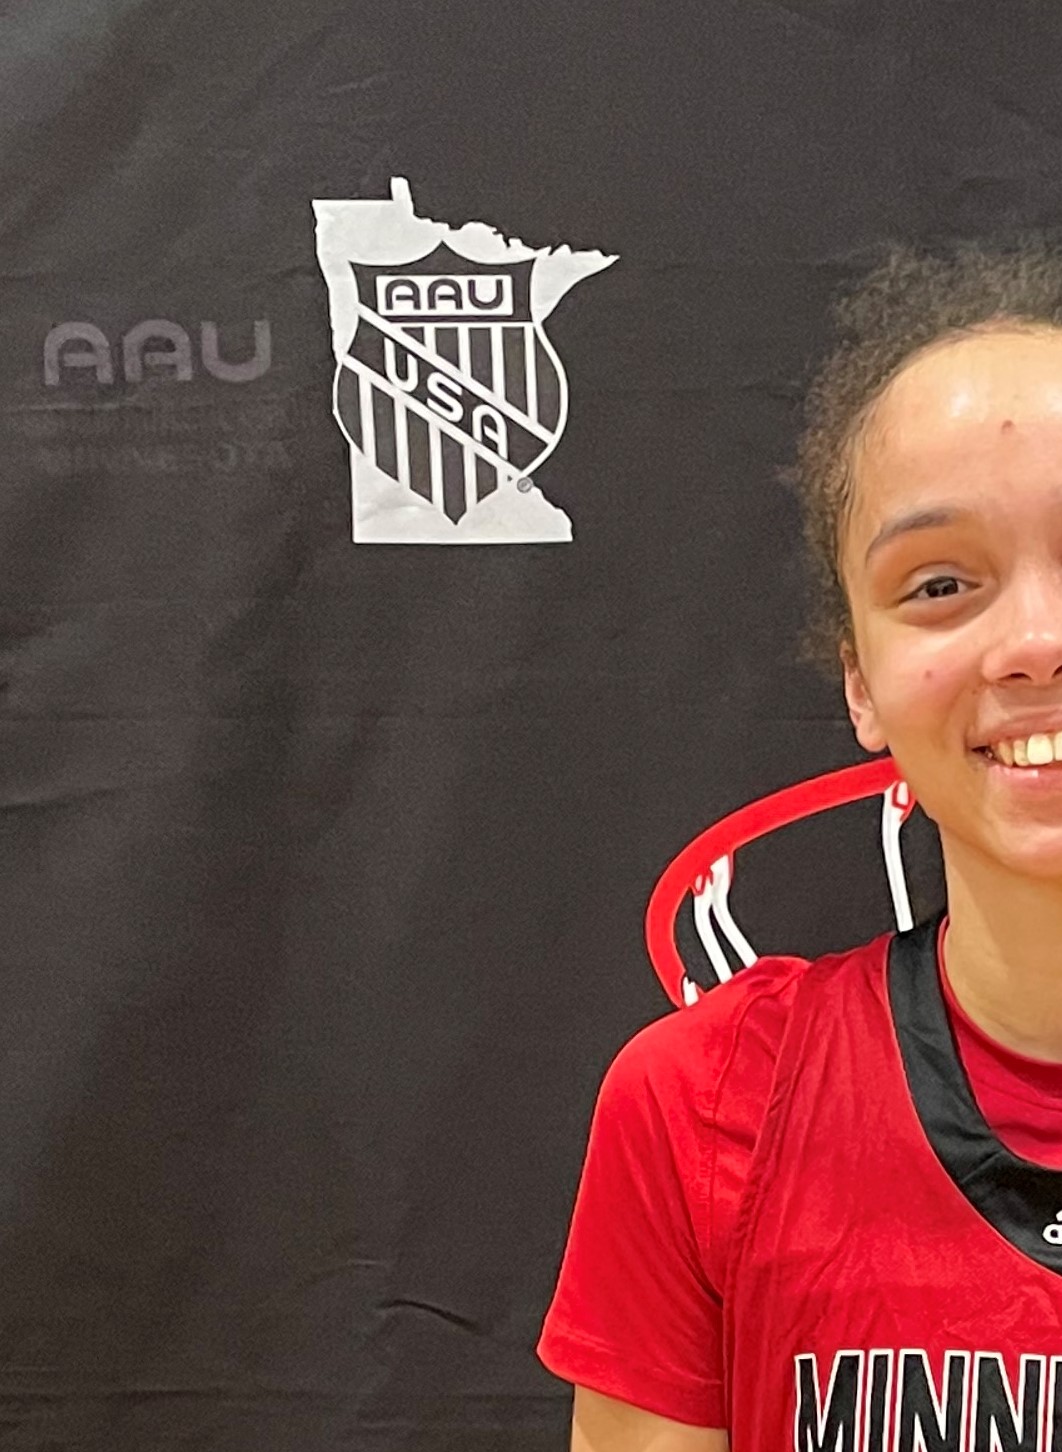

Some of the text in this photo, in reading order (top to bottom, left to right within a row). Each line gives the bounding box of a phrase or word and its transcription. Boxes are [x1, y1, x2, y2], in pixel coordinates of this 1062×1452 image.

[384, 277, 504, 311] AAU
[43, 318, 272, 386] AAU
[384, 336, 509, 461] USA
